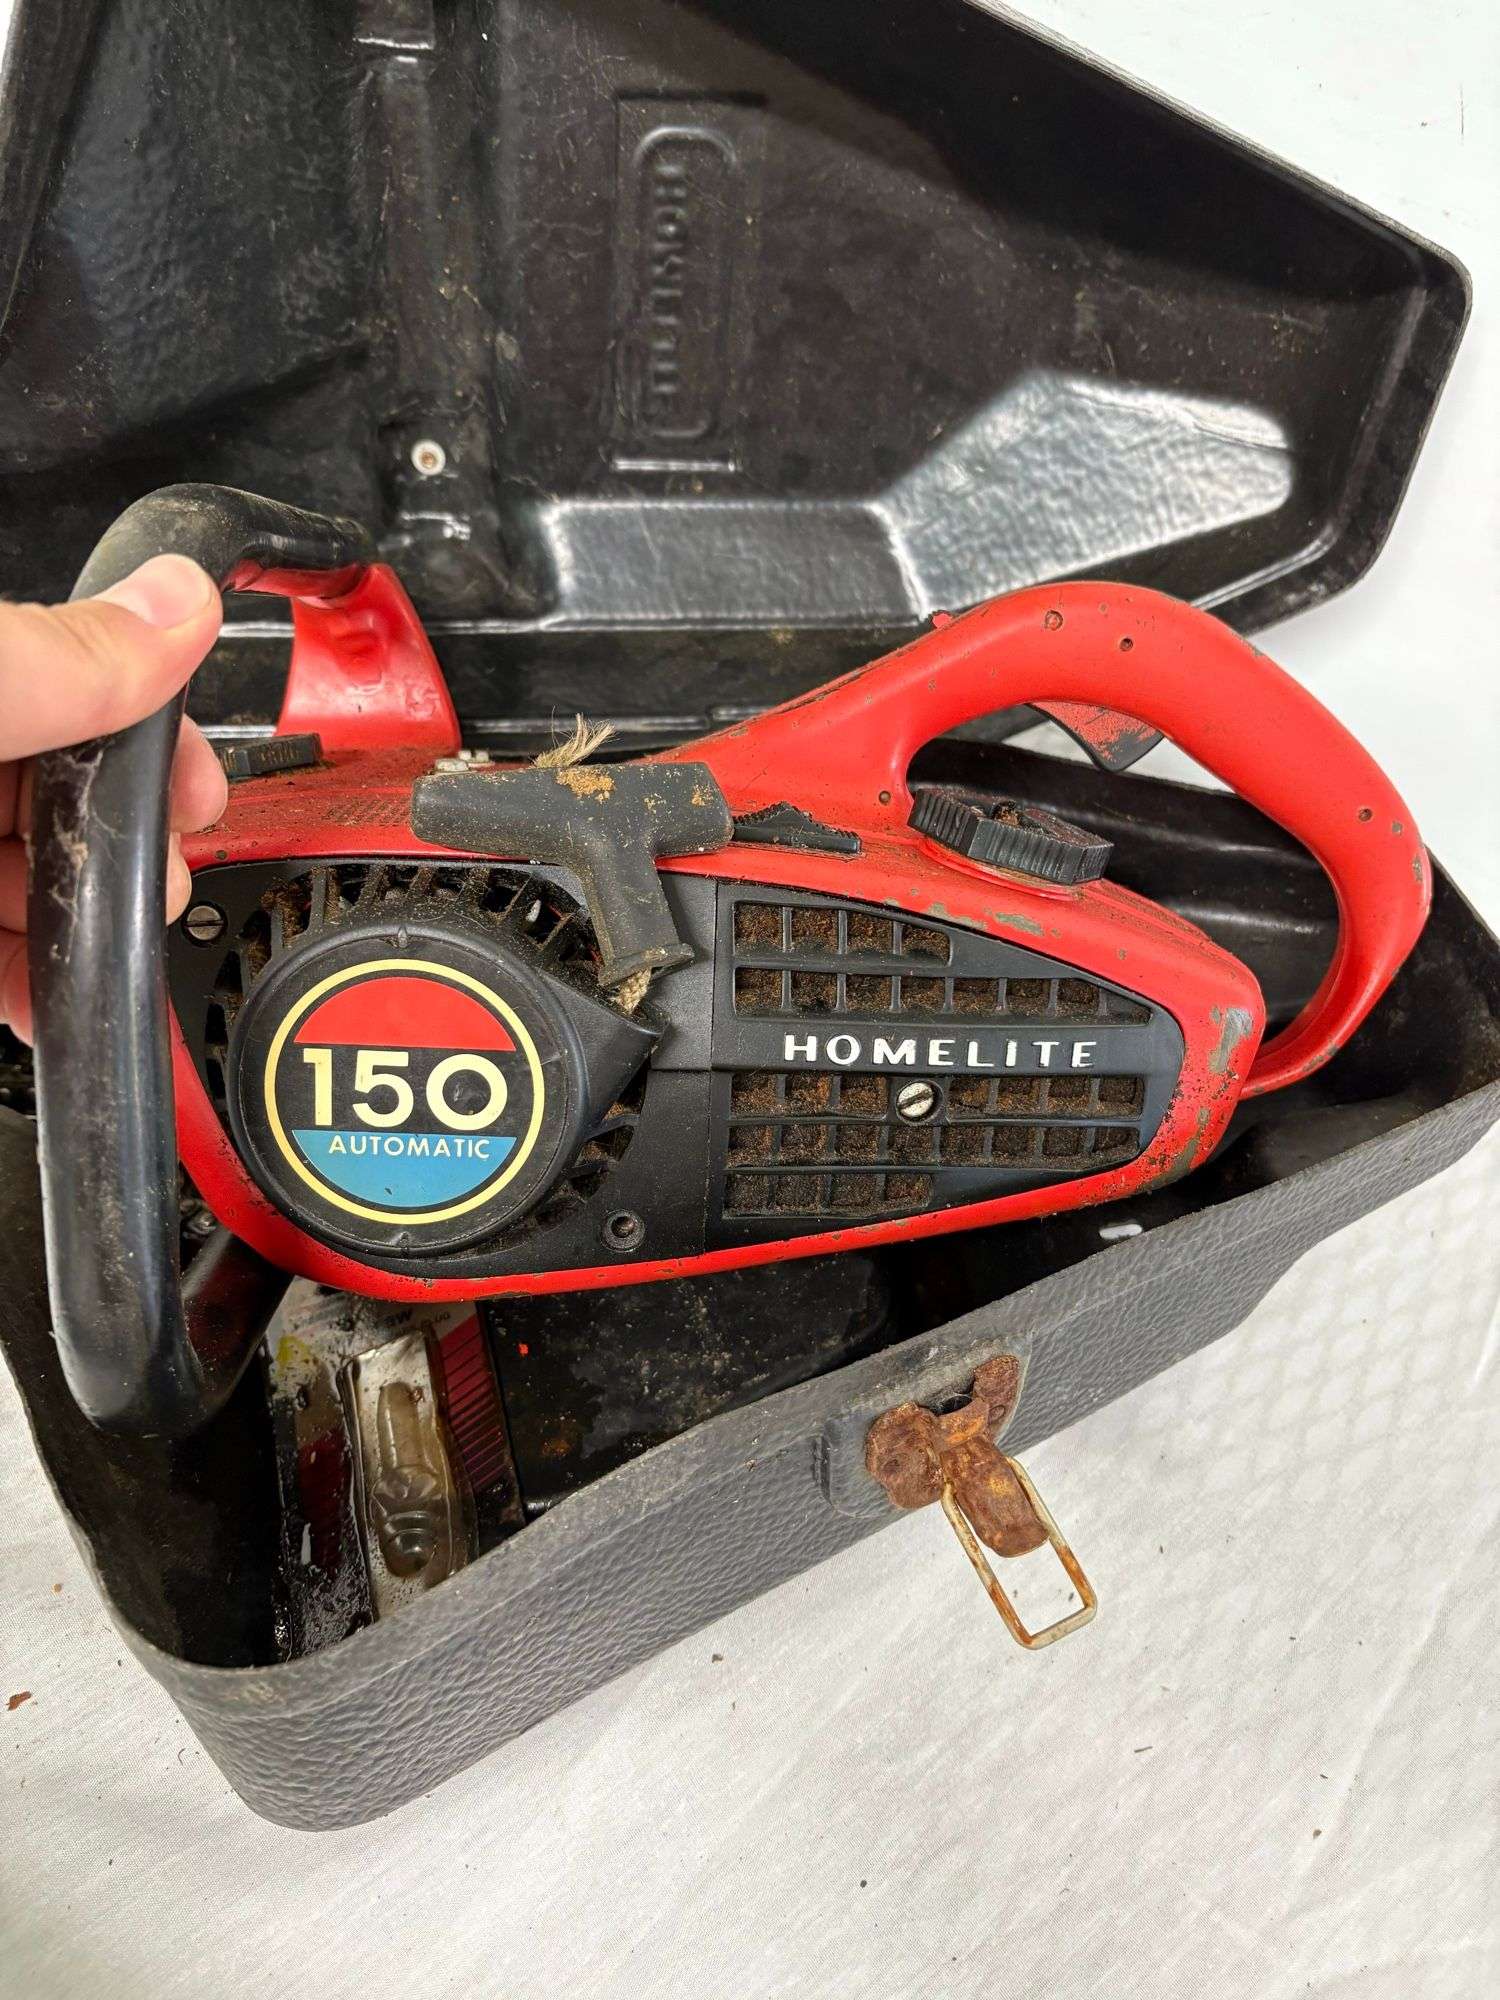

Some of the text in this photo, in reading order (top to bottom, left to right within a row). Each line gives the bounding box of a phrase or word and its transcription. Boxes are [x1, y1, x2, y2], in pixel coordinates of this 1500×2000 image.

[783, 1034, 1098, 1068] HOMELITE
[302, 1047, 509, 1132] 150
[328, 1134, 490, 1159] AUTOMATIC
